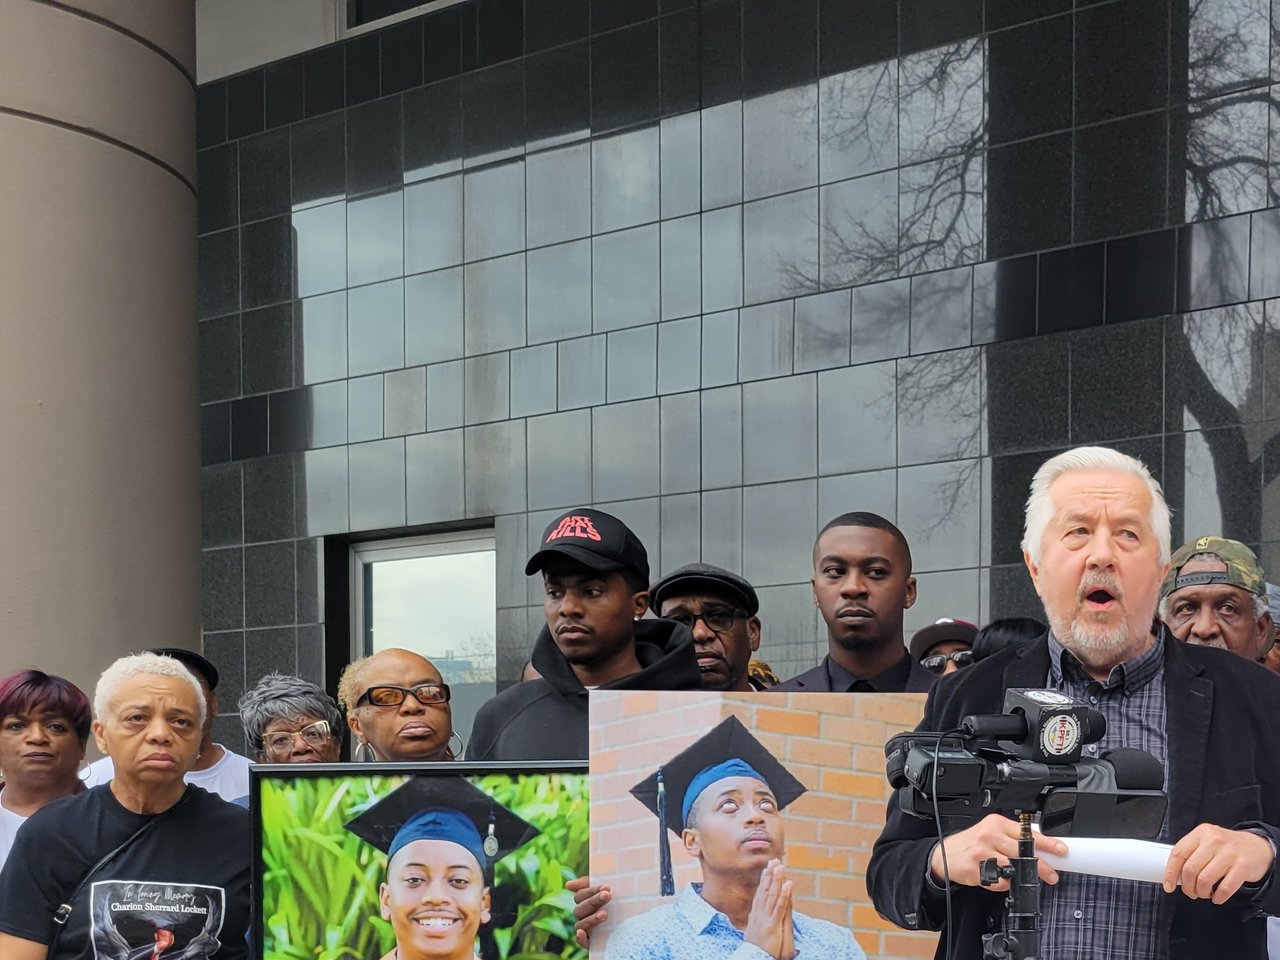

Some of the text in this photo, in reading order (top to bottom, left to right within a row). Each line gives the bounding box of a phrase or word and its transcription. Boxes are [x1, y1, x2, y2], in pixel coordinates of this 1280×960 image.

[546, 526, 602, 543] KILLS
[1056, 722, 1066, 749] KPFT
[111, 902, 208, 915] Charion Sherrard Lockett
